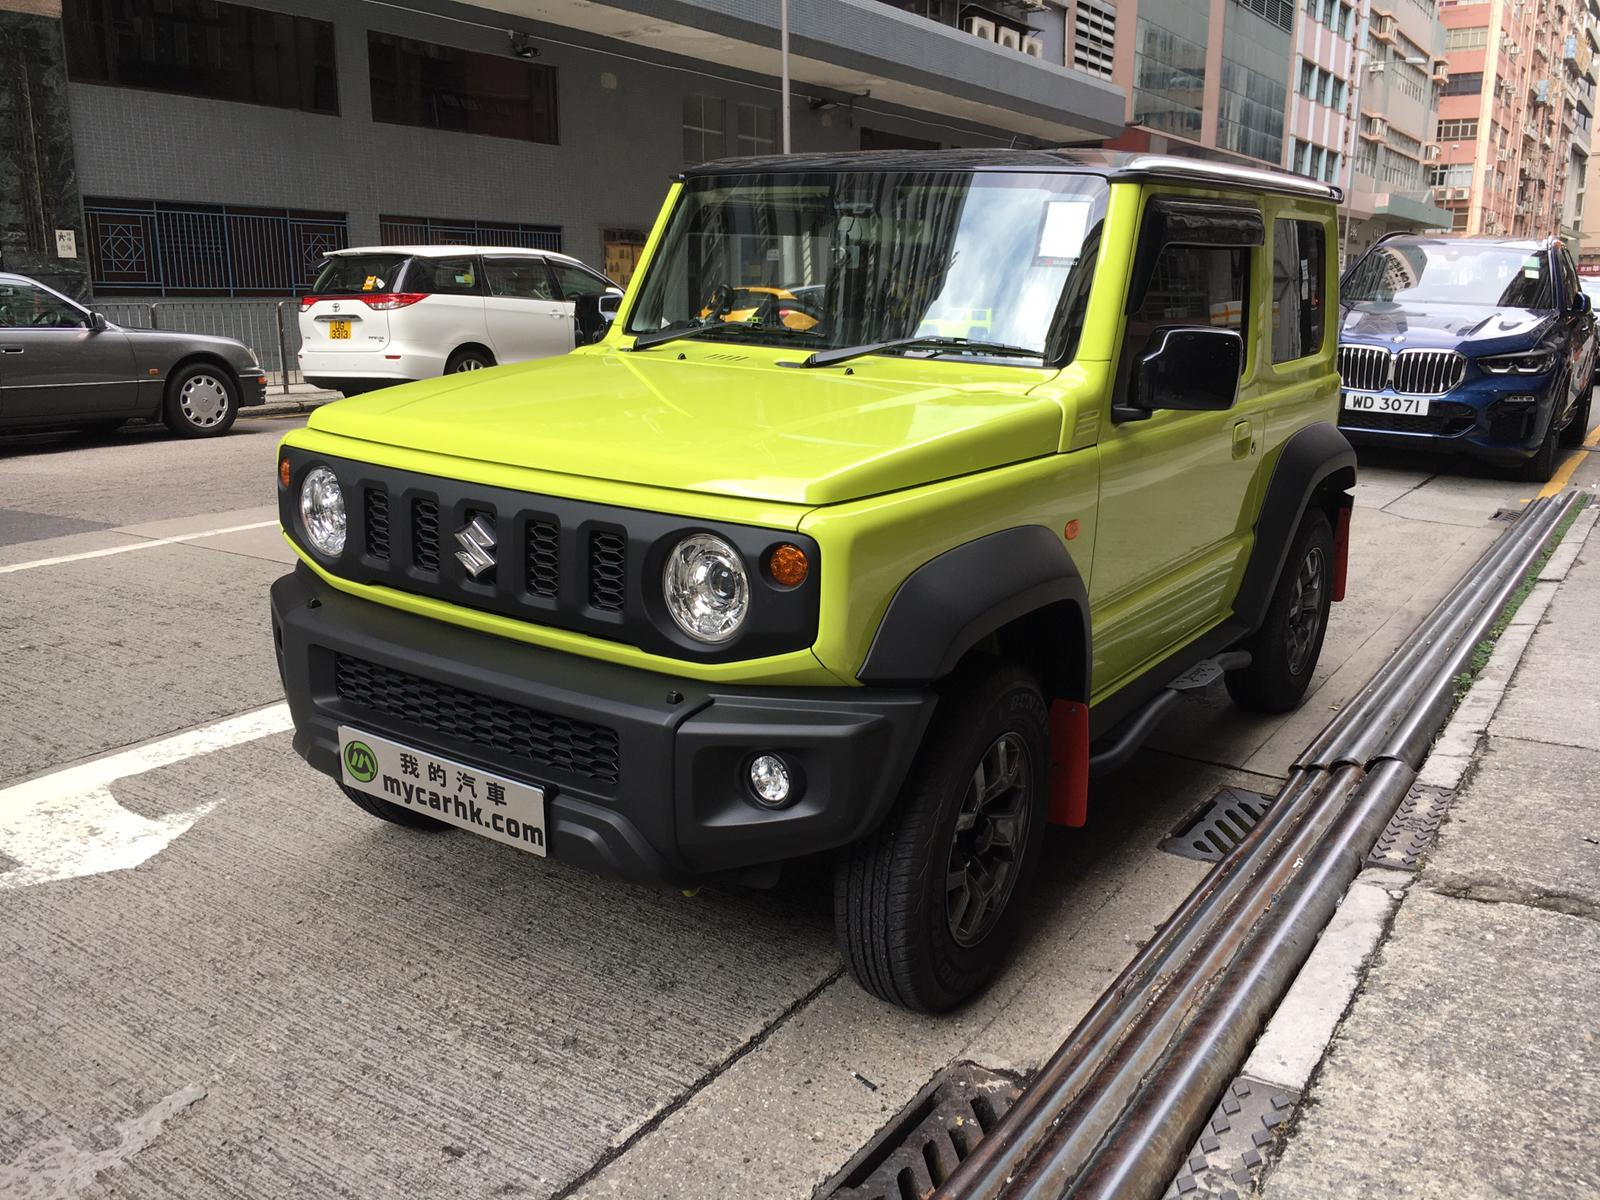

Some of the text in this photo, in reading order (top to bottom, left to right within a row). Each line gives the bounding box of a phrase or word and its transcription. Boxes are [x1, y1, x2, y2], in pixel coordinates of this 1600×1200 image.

[1353, 396, 1420, 413] WD 3071
[399, 752, 508, 808] 我的汽車
[382, 773, 544, 847] mycarhk.com
